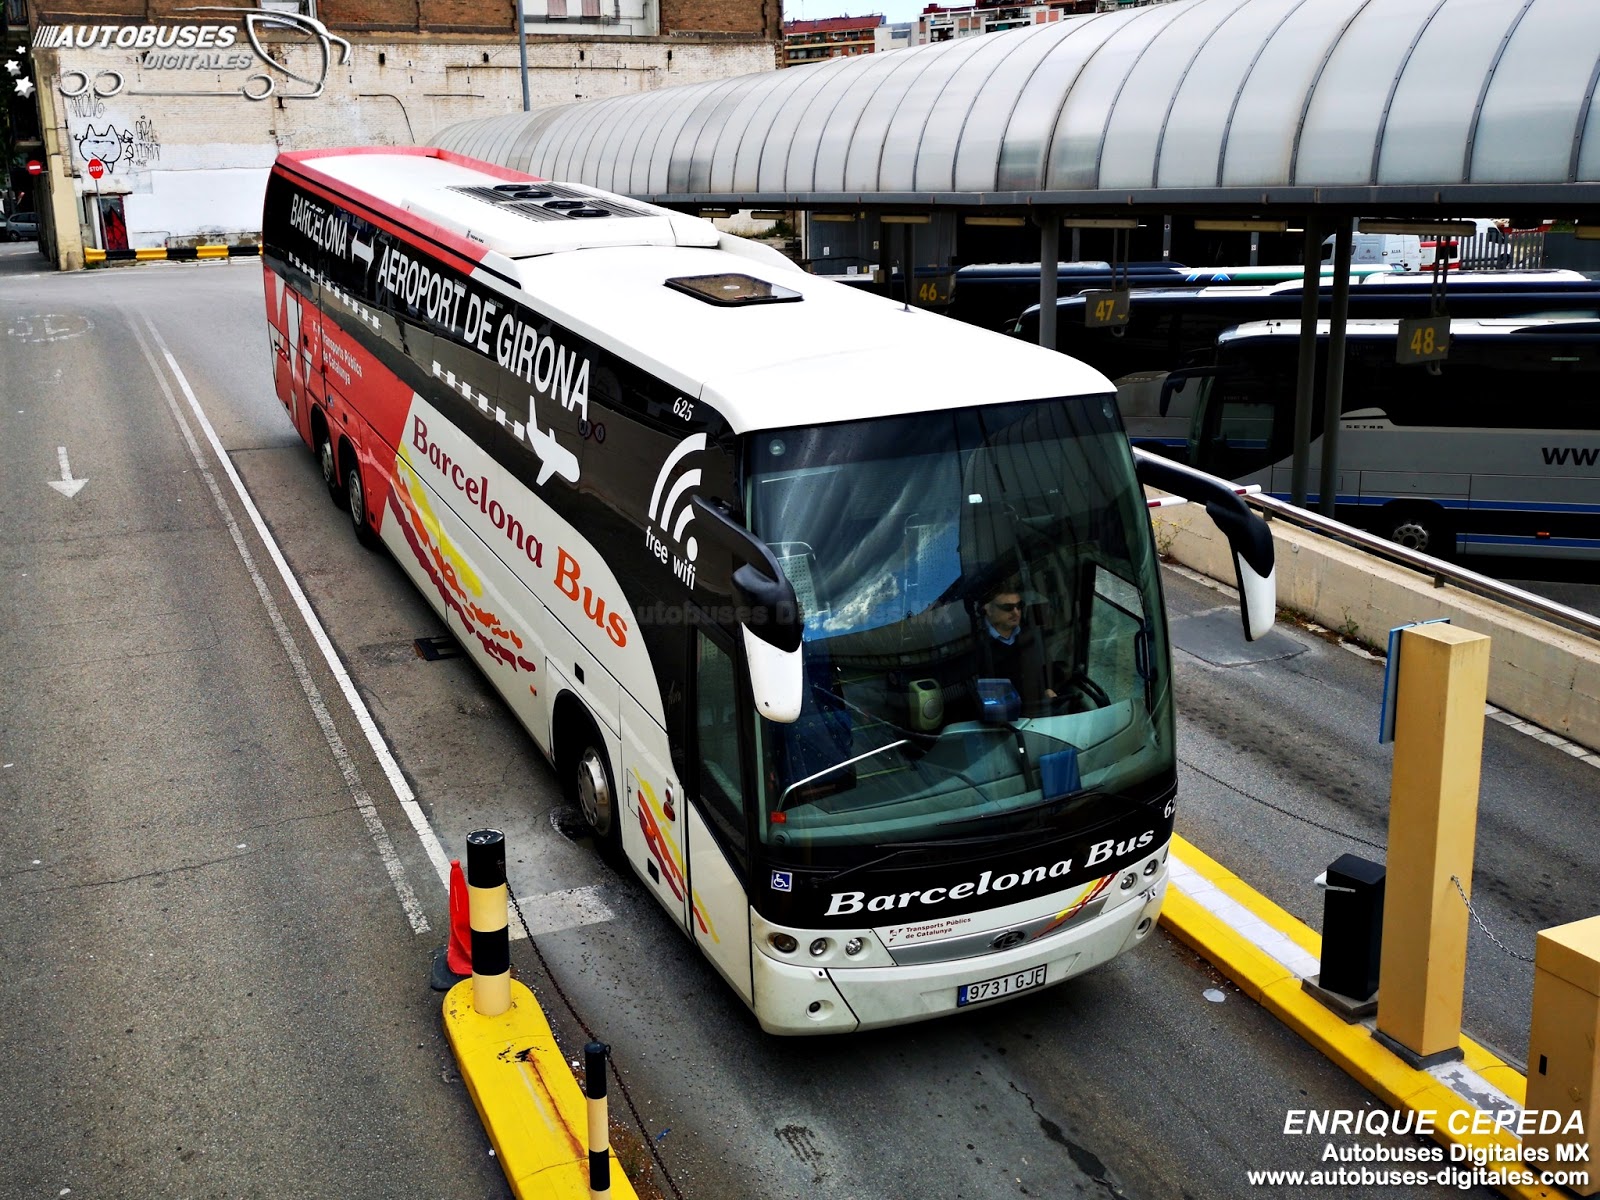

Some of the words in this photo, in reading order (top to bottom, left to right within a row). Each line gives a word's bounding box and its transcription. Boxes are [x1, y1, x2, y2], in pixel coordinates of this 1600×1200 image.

[89, 165, 103, 173] STOP
[919, 283, 938, 301] 46
[290, 193, 349, 260] BARCELONA
[377, 245, 467, 333] AEROPORT
[464, 299, 497, 355] DE
[496, 315, 591, 422] GIRONA
[1095, 300, 1115, 321] 47
[1410, 327, 1435, 355] 48
[673, 397, 693, 422] 625
[413, 414, 543, 569] Barcelona
[553, 545, 629, 648] Bus
[646, 526, 668, 565] free
[673, 555, 697, 591] wifi
[824, 859, 1072, 917] Barcelona
[1084, 829, 1155, 868] Bus
[905, 922, 944, 933] Transports
[945, 917, 972, 927] Públics
[916, 928, 953, 938] Catalunya
[970, 978, 1009, 1000] 9731
